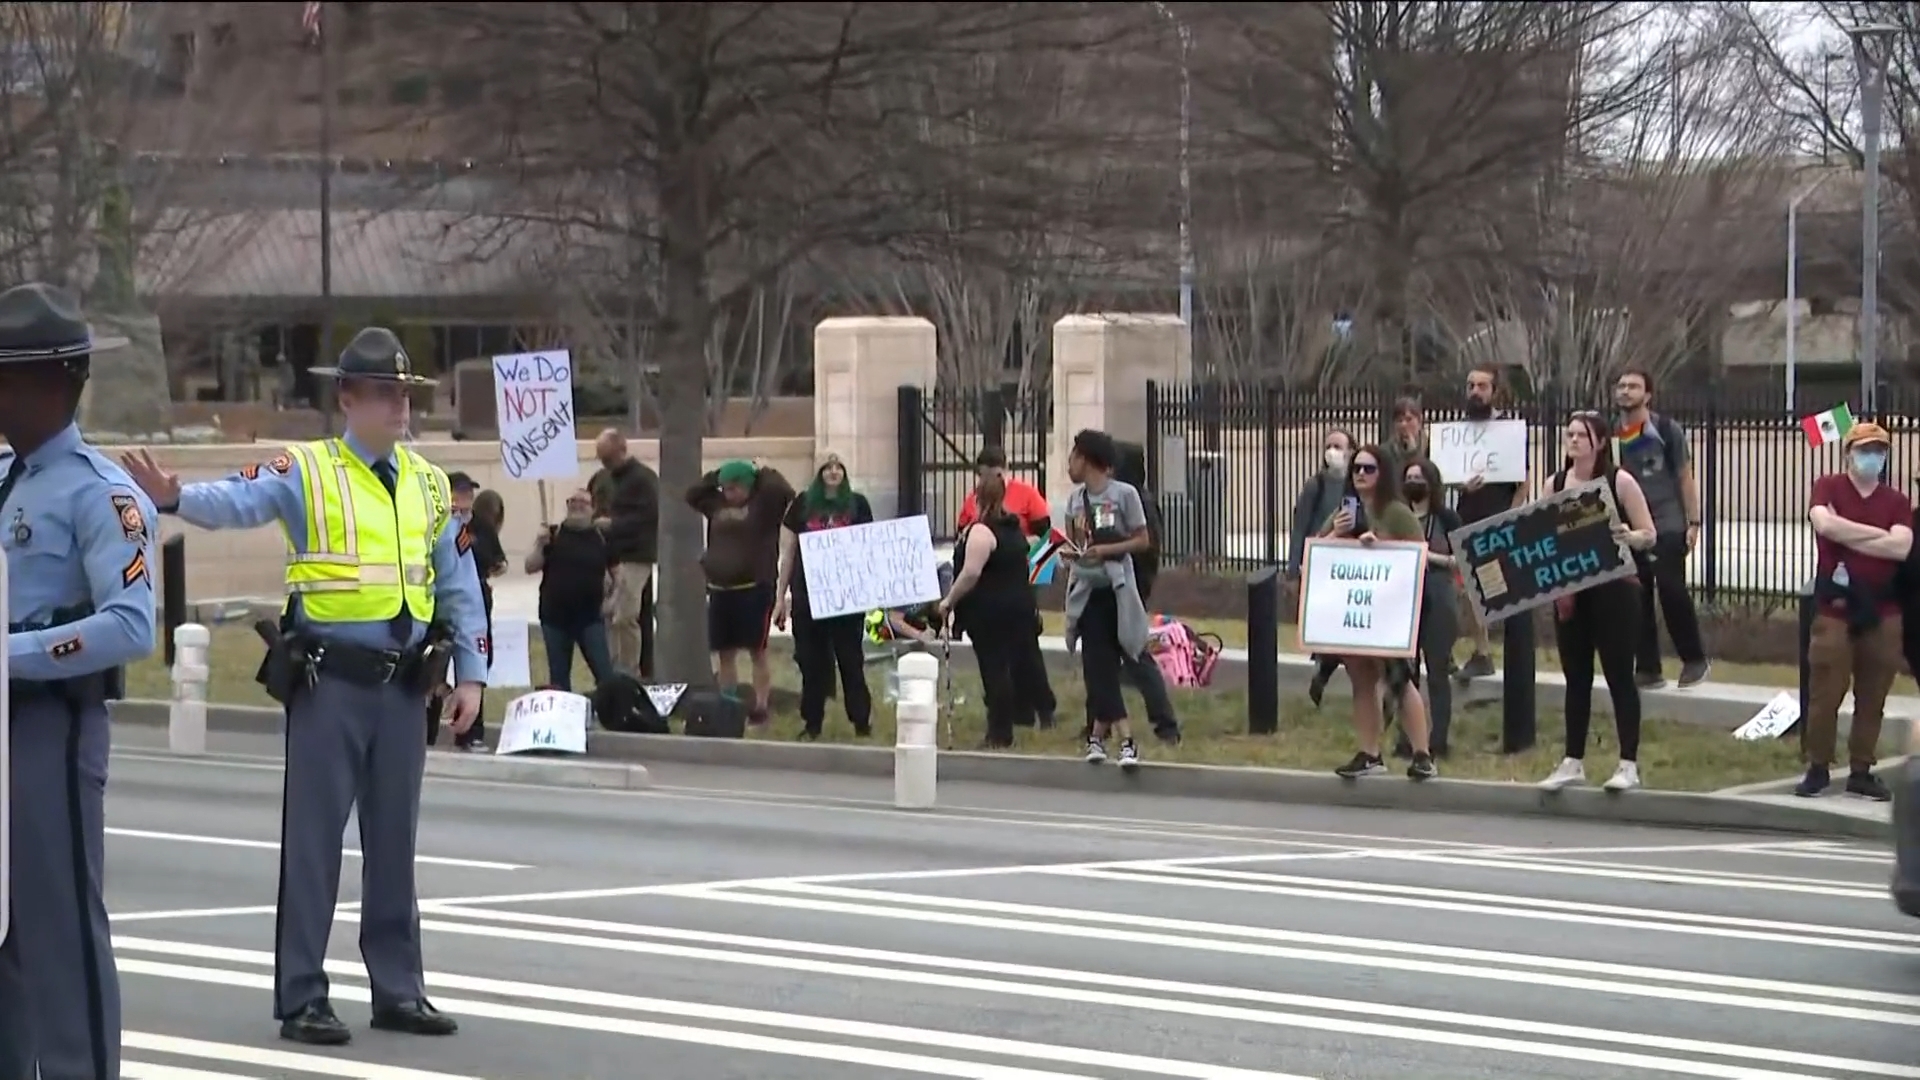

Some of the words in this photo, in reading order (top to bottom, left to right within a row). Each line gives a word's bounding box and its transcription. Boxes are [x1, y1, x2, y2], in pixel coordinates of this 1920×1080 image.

[496, 358, 530, 382] We
[533, 356, 569, 382] Do
[504, 385, 558, 422] NOT
[1441, 424, 1486, 450] FUCK
[1463, 450, 1499, 473] ICE
[805, 531, 842, 551] OUR
[1472, 525, 1516, 558] EAT
[1508, 536, 1558, 570] THE
[1330, 563, 1392, 582] EQUALITY
[1534, 548, 1600, 588] RICH
[1347, 588, 1373, 606] FOR
[1343, 610, 1372, 629] ALL!
[532, 727, 556, 745] Kids
